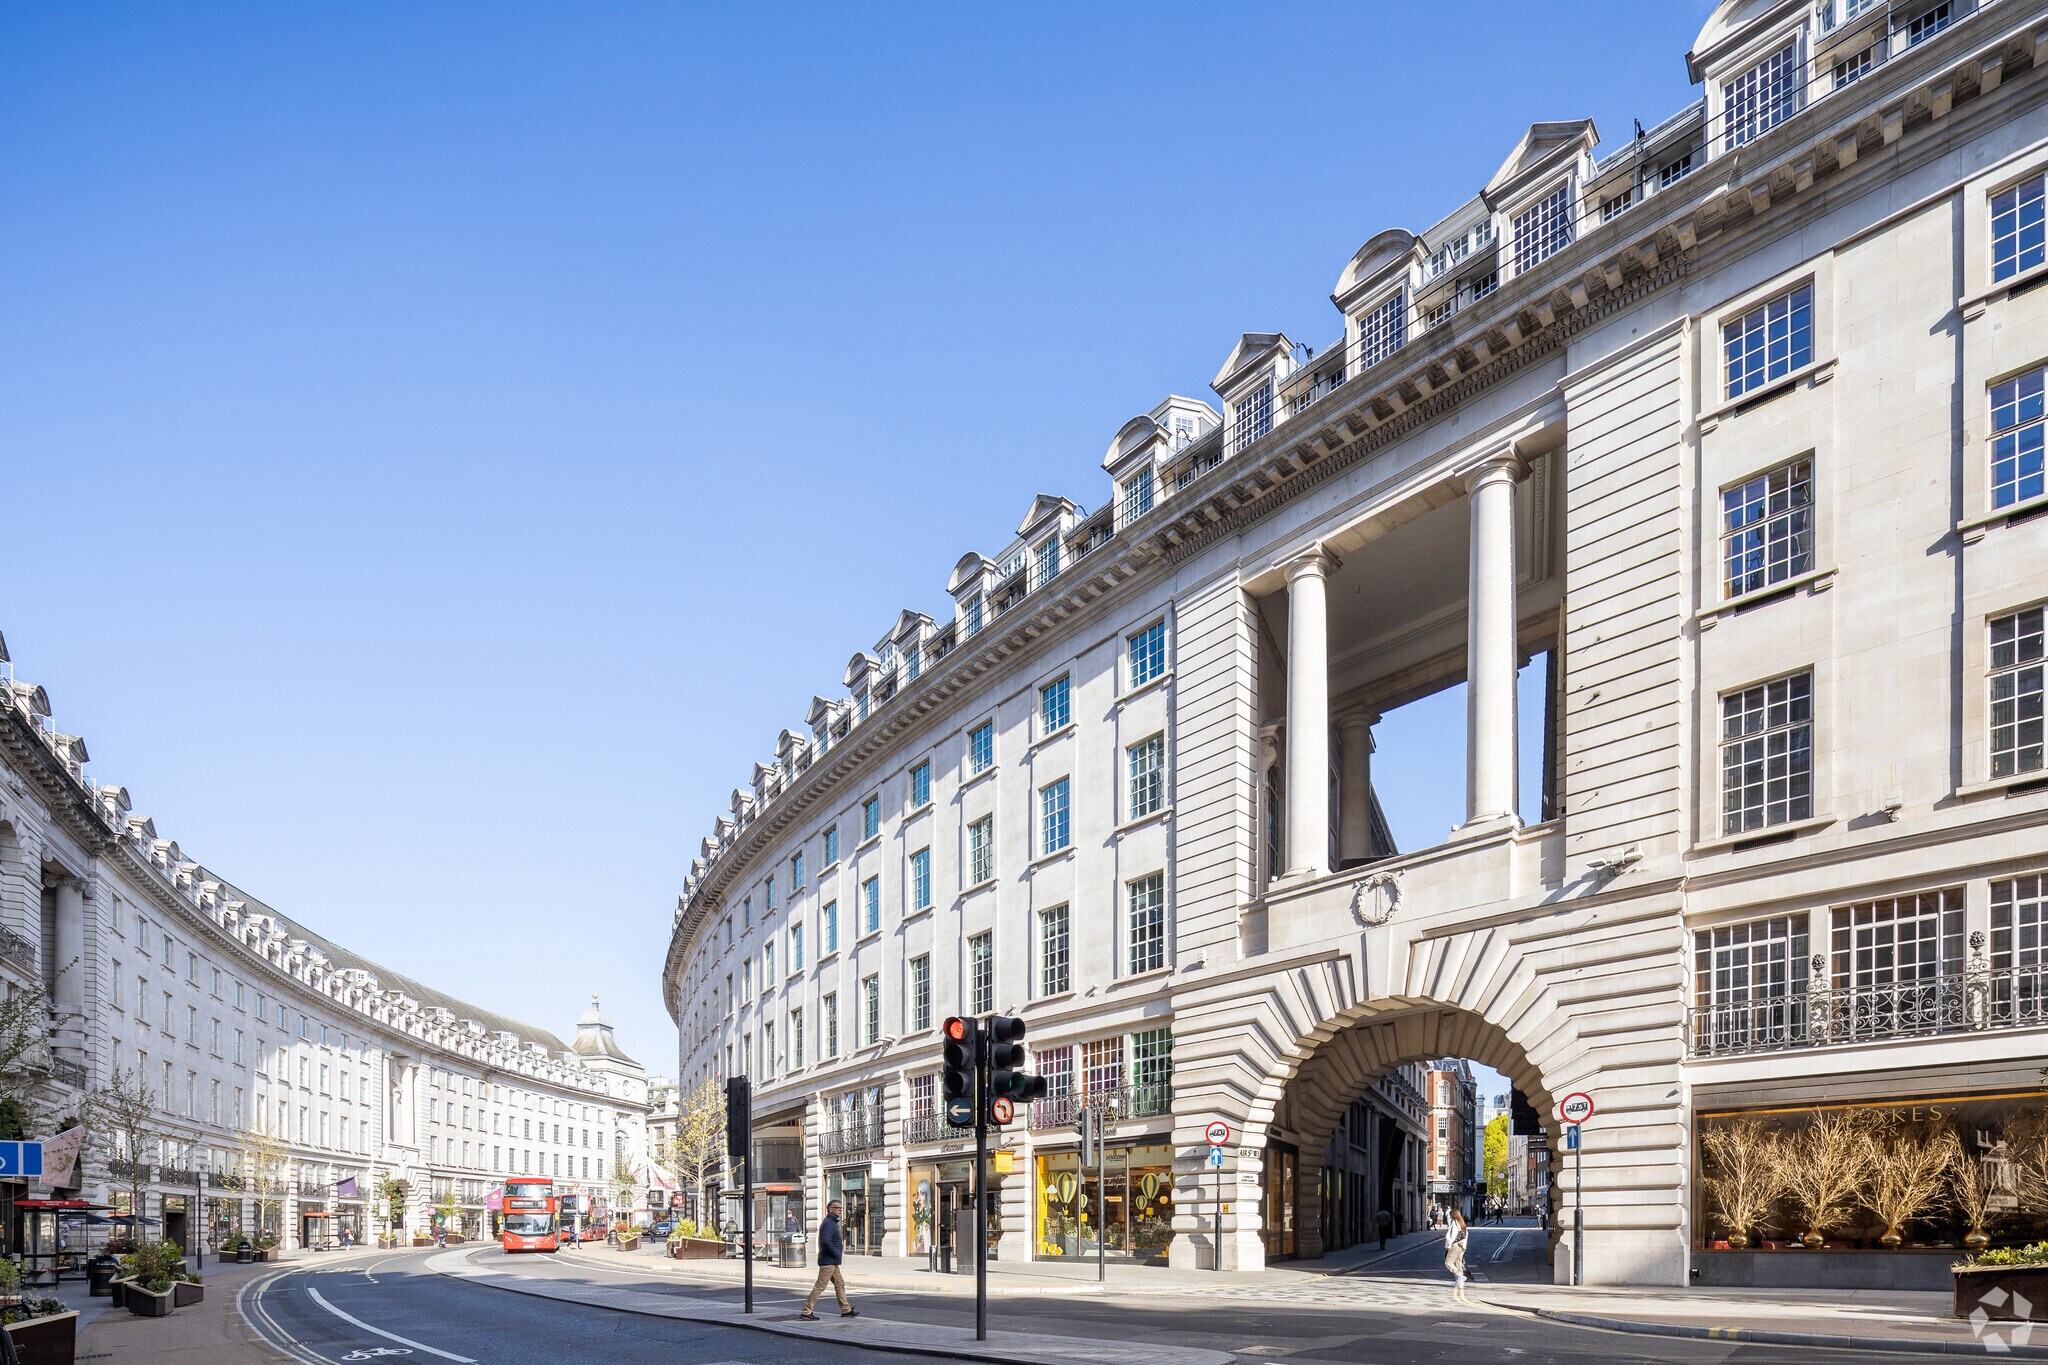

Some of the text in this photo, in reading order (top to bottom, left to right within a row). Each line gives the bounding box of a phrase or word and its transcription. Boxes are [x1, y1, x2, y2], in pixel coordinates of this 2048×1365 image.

[1850, 1105, 1943, 1125] CAKES
[836, 1151, 873, 1166] PEREGRINE
[1239, 1149, 1247, 1157] AIR
